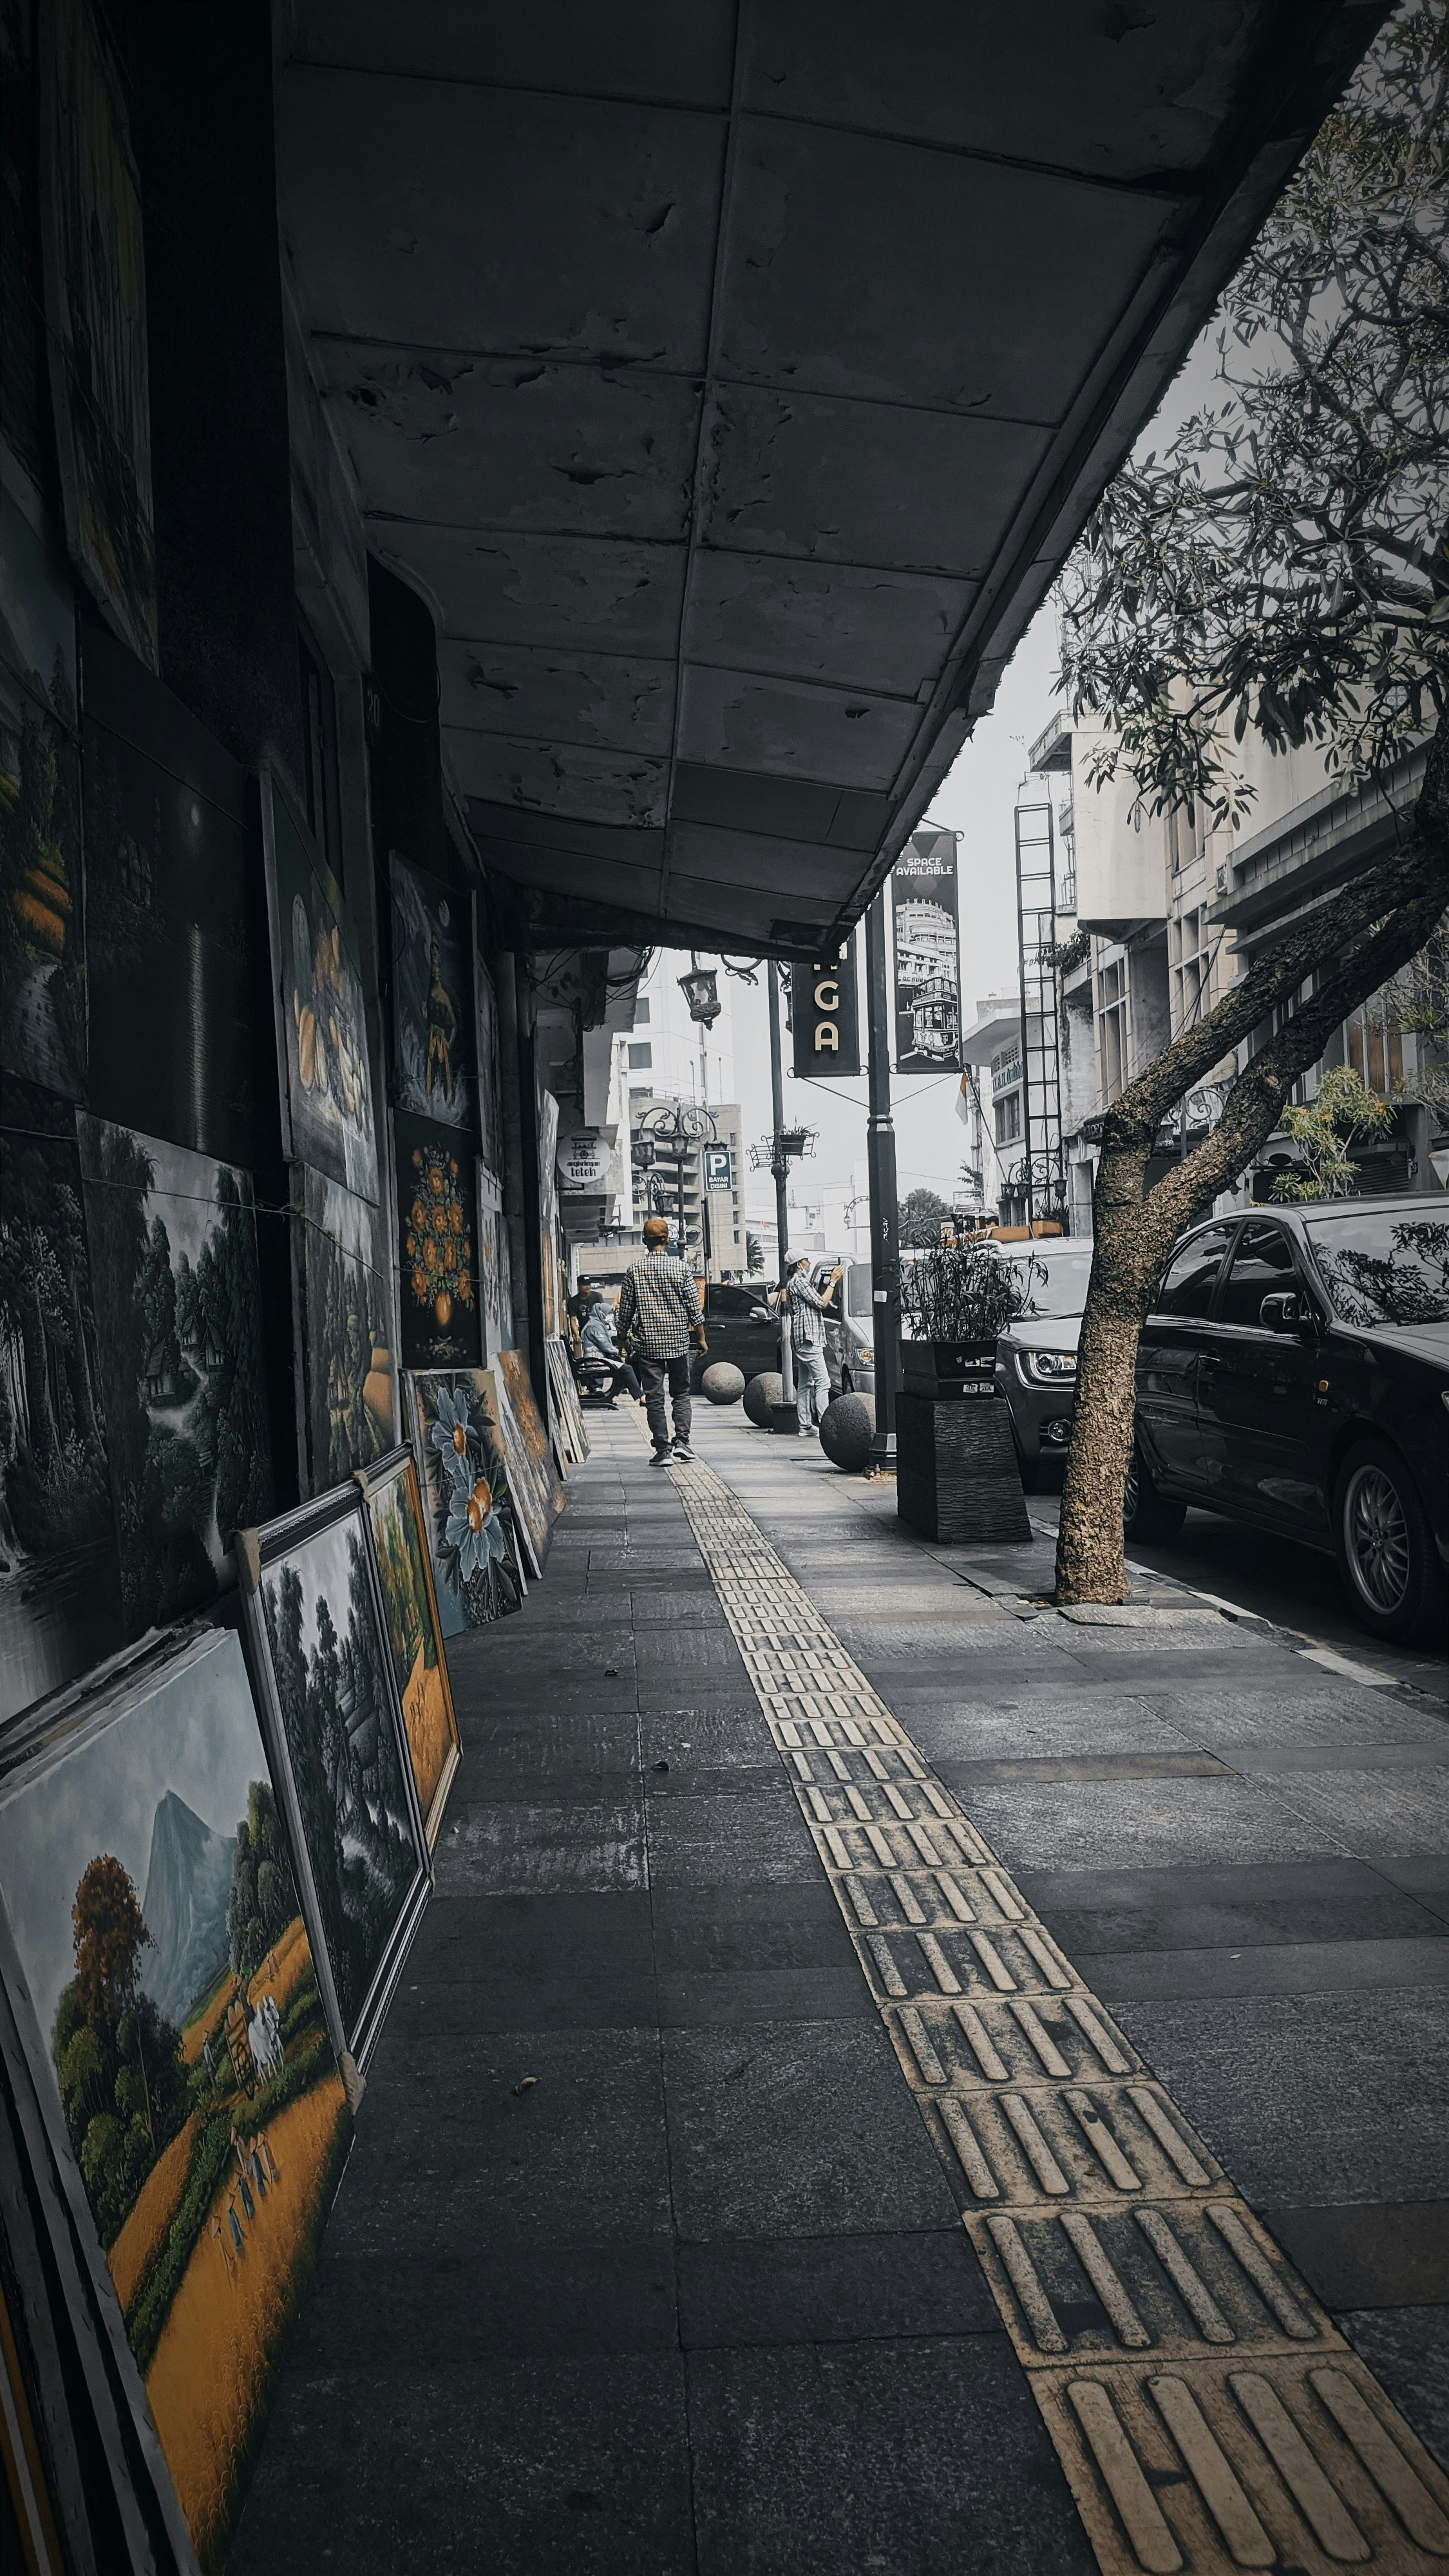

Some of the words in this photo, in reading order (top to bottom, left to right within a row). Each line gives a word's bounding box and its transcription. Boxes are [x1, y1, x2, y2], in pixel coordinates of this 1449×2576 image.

[907, 857, 942, 867] SPACE
[896, 866, 954, 876] AVAILABLE
[710, 1154, 727, 1176] P
